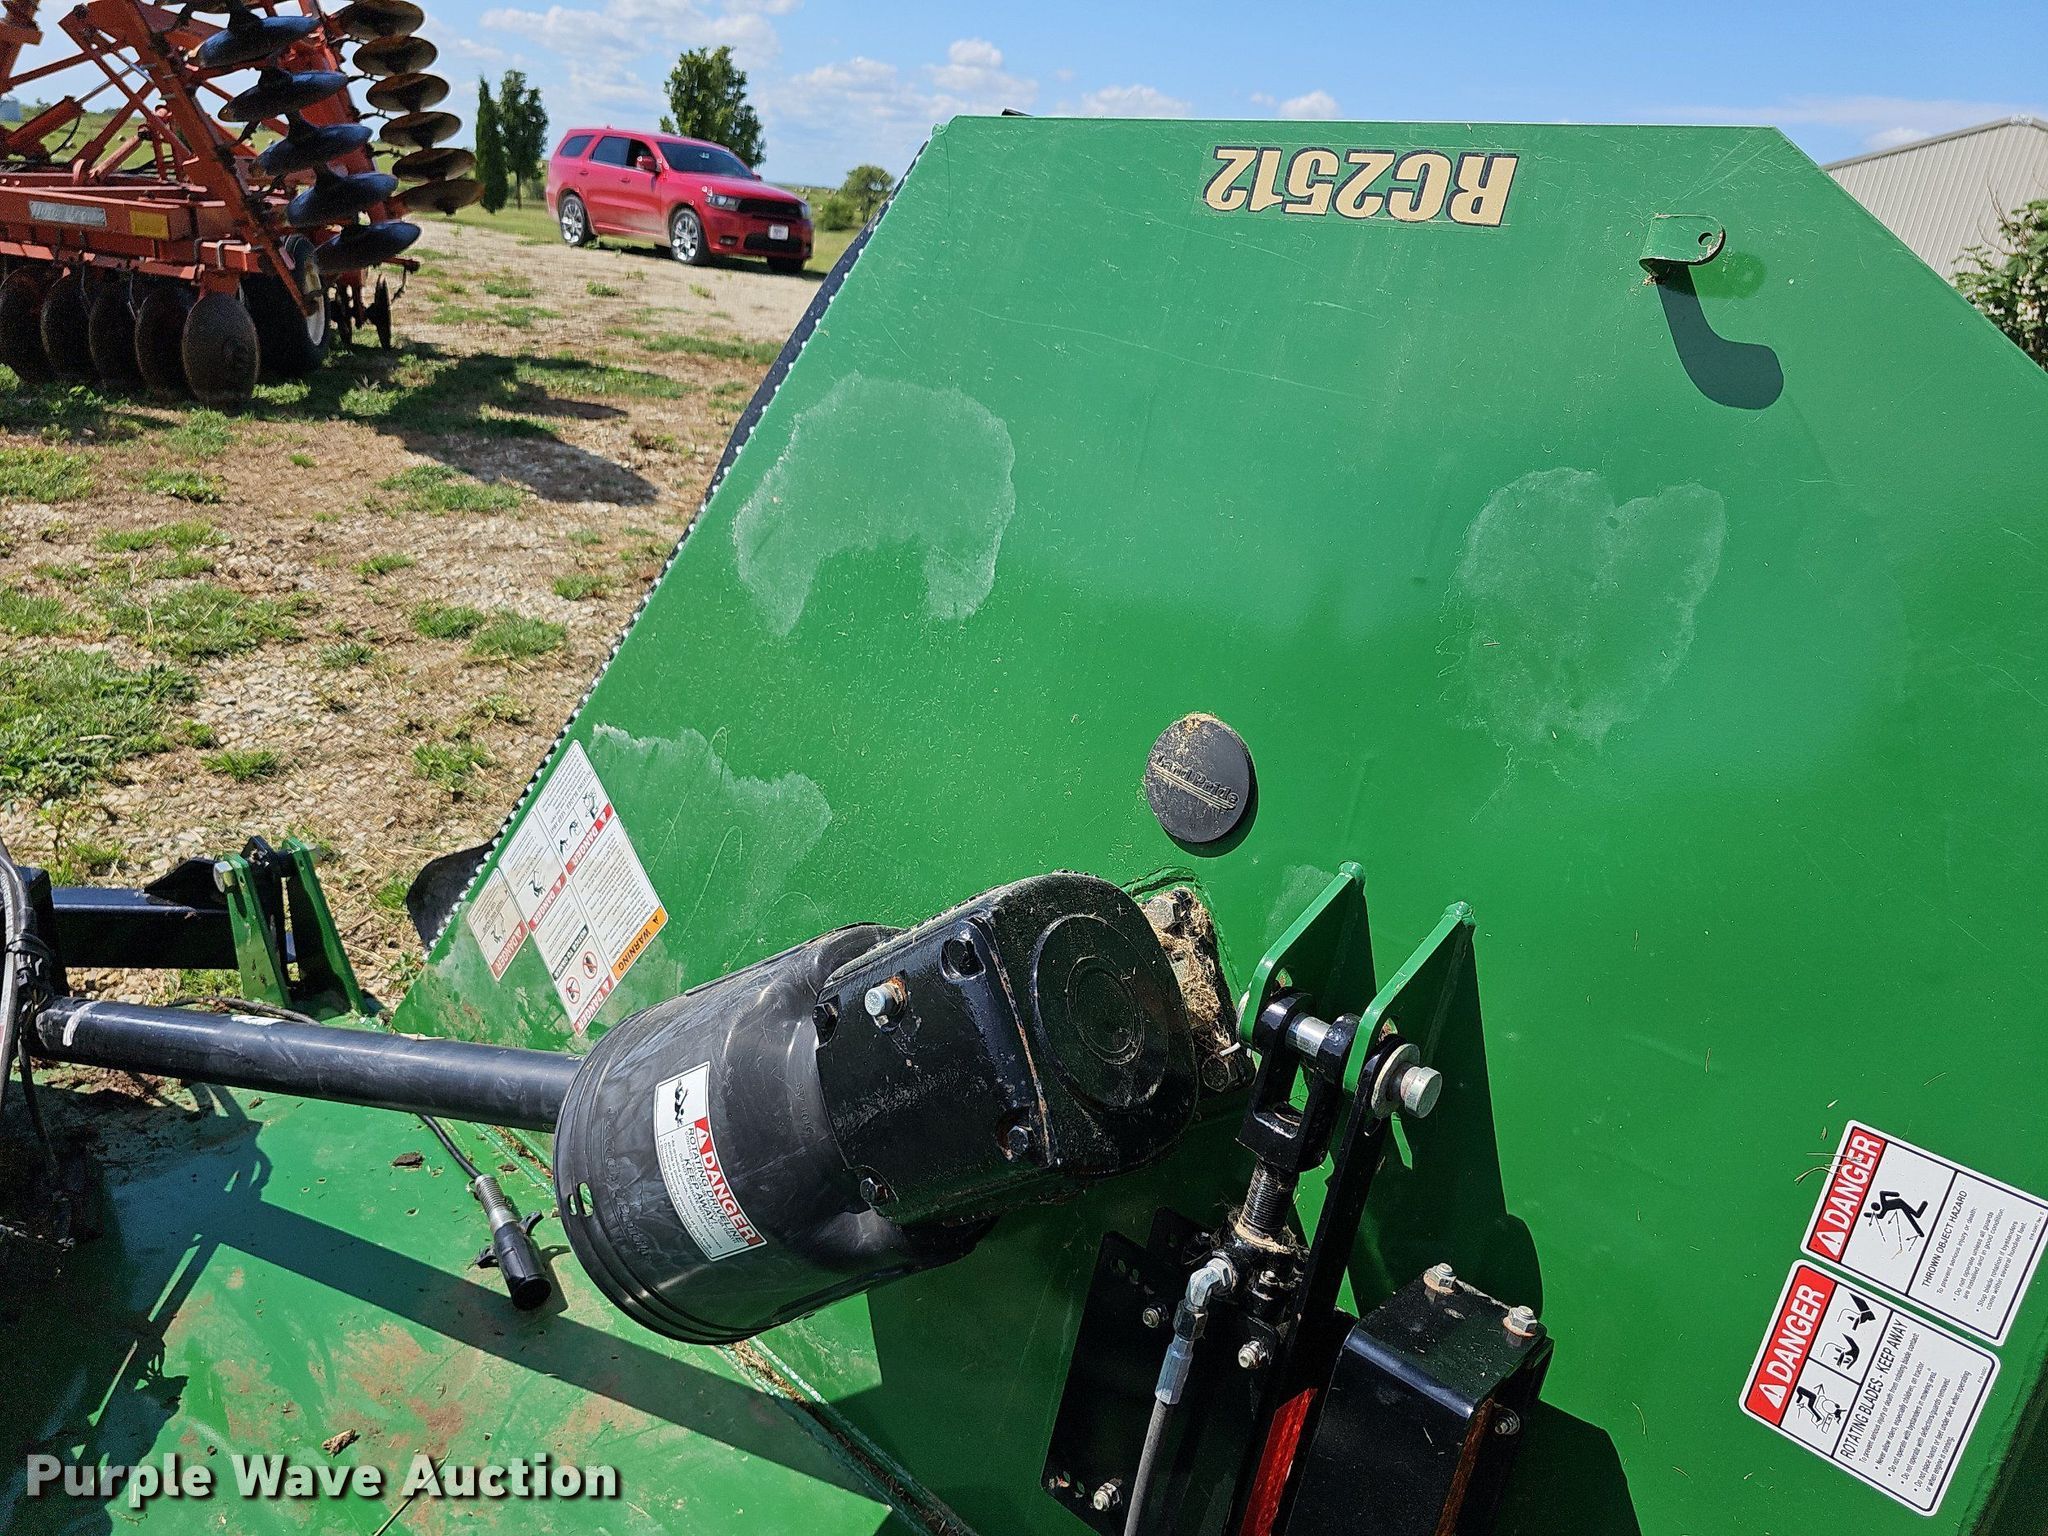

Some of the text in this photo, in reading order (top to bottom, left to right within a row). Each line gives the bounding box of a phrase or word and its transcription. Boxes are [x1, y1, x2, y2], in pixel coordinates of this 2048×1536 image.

[1203, 146, 1519, 226] RC2512
[1192, 772, 1239, 804] Pride
[574, 830, 598, 864] DANGER
[534, 893, 556, 922] DANGER
[497, 938, 518, 970] DANGER
[618, 928, 651, 971] WARNING
[578, 990, 604, 1028] DANGER
[684, 1157, 718, 1224] KEEP AWAY!
[688, 1126, 745, 1243] ROTATING DRIVELINE
[1822, 1133, 1880, 1230] DANGER
[701, 1150, 758, 1240] DANGER
[1965, 1205, 1977, 1224] death:
[1921, 1189, 1967, 1288] THROWN OBJECT HAZARD
[1956, 1230, 1968, 1247] injury
[1965, 1266, 1979, 1290] installed
[1975, 1254, 1984, 1267] and
[1982, 1233, 1994, 1250] good
[1988, 1205, 2004, 1234] condition.
[1947, 1245, 1960, 1266] serious
[1953, 1210, 1995, 1296] Do not operate unless all guards
[1976, 1292, 1988, 1307] Stop
[1982, 1276, 1993, 1293] blade
[1989, 1254, 2003, 1277] rotation
[2000, 1219, 2019, 1251] bystanders
[1986, 1220, 2026, 1310] come within several hundred feet.
[1939, 1266, 1953, 1288] prevent
[1936, 1286, 1943, 1294] To
[1765, 1281, 1825, 1384] DANGER
[1884, 1318, 1908, 1350] AWAY
[1874, 1345, 1896, 1374] KEEP
[1900, 1350, 1911, 1364] blade
[1893, 1362, 1907, 1383] rotating
[1954, 1368, 1972, 1394] operating
[1857, 1375, 1884, 1415] BLADES
[1888, 1380, 1898, 1393] from
[1918, 1381, 1933, 1402] mowing
[1883, 1391, 1893, 1406] death
[1949, 1391, 1960, 1405] when
[1875, 1410, 1887, 1425] injury
[1891, 1402, 1908, 1427] especially
[1905, 1404, 1923, 1431] bystanders
[1944, 1404, 1955, 1417] deck
[1868, 1422, 1880, 1441] serious
[1885, 1423, 1898, 1441] riders,
[1938, 1415, 1950, 1431] under
[1839, 1411, 1868, 1460] ROTATING
[1901, 1428, 1911, 1440] with
[1914, 1435, 1924, 1447] with
[1934, 1428, 1944, 1440] feet
[1861, 1439, 1875, 1458] prevent
[1880, 1438, 1891, 1452] allow
[1894, 1438, 1908, 1458] operate
[1925, 1443, 1937, 1460] hands
[1859, 1455, 1867, 1463] To
[1874, 1450, 1885, 1465] Never
[1890, 1455, 1899, 1465] not
[1907, 1445, 1921, 1466] operate
[1920, 1457, 1933, 1473] place
[1931, 1456, 1945, 1475] engine
[1887, 1463, 1896, 1472] Do
[1900, 1470, 1909, 1480] Do
[1903, 1462, 1912, 1473] not
[1917, 1469, 1926, 1480] not
[1913, 1478, 1922, 1487] Do
[1926, 1472, 1937, 1486] when
